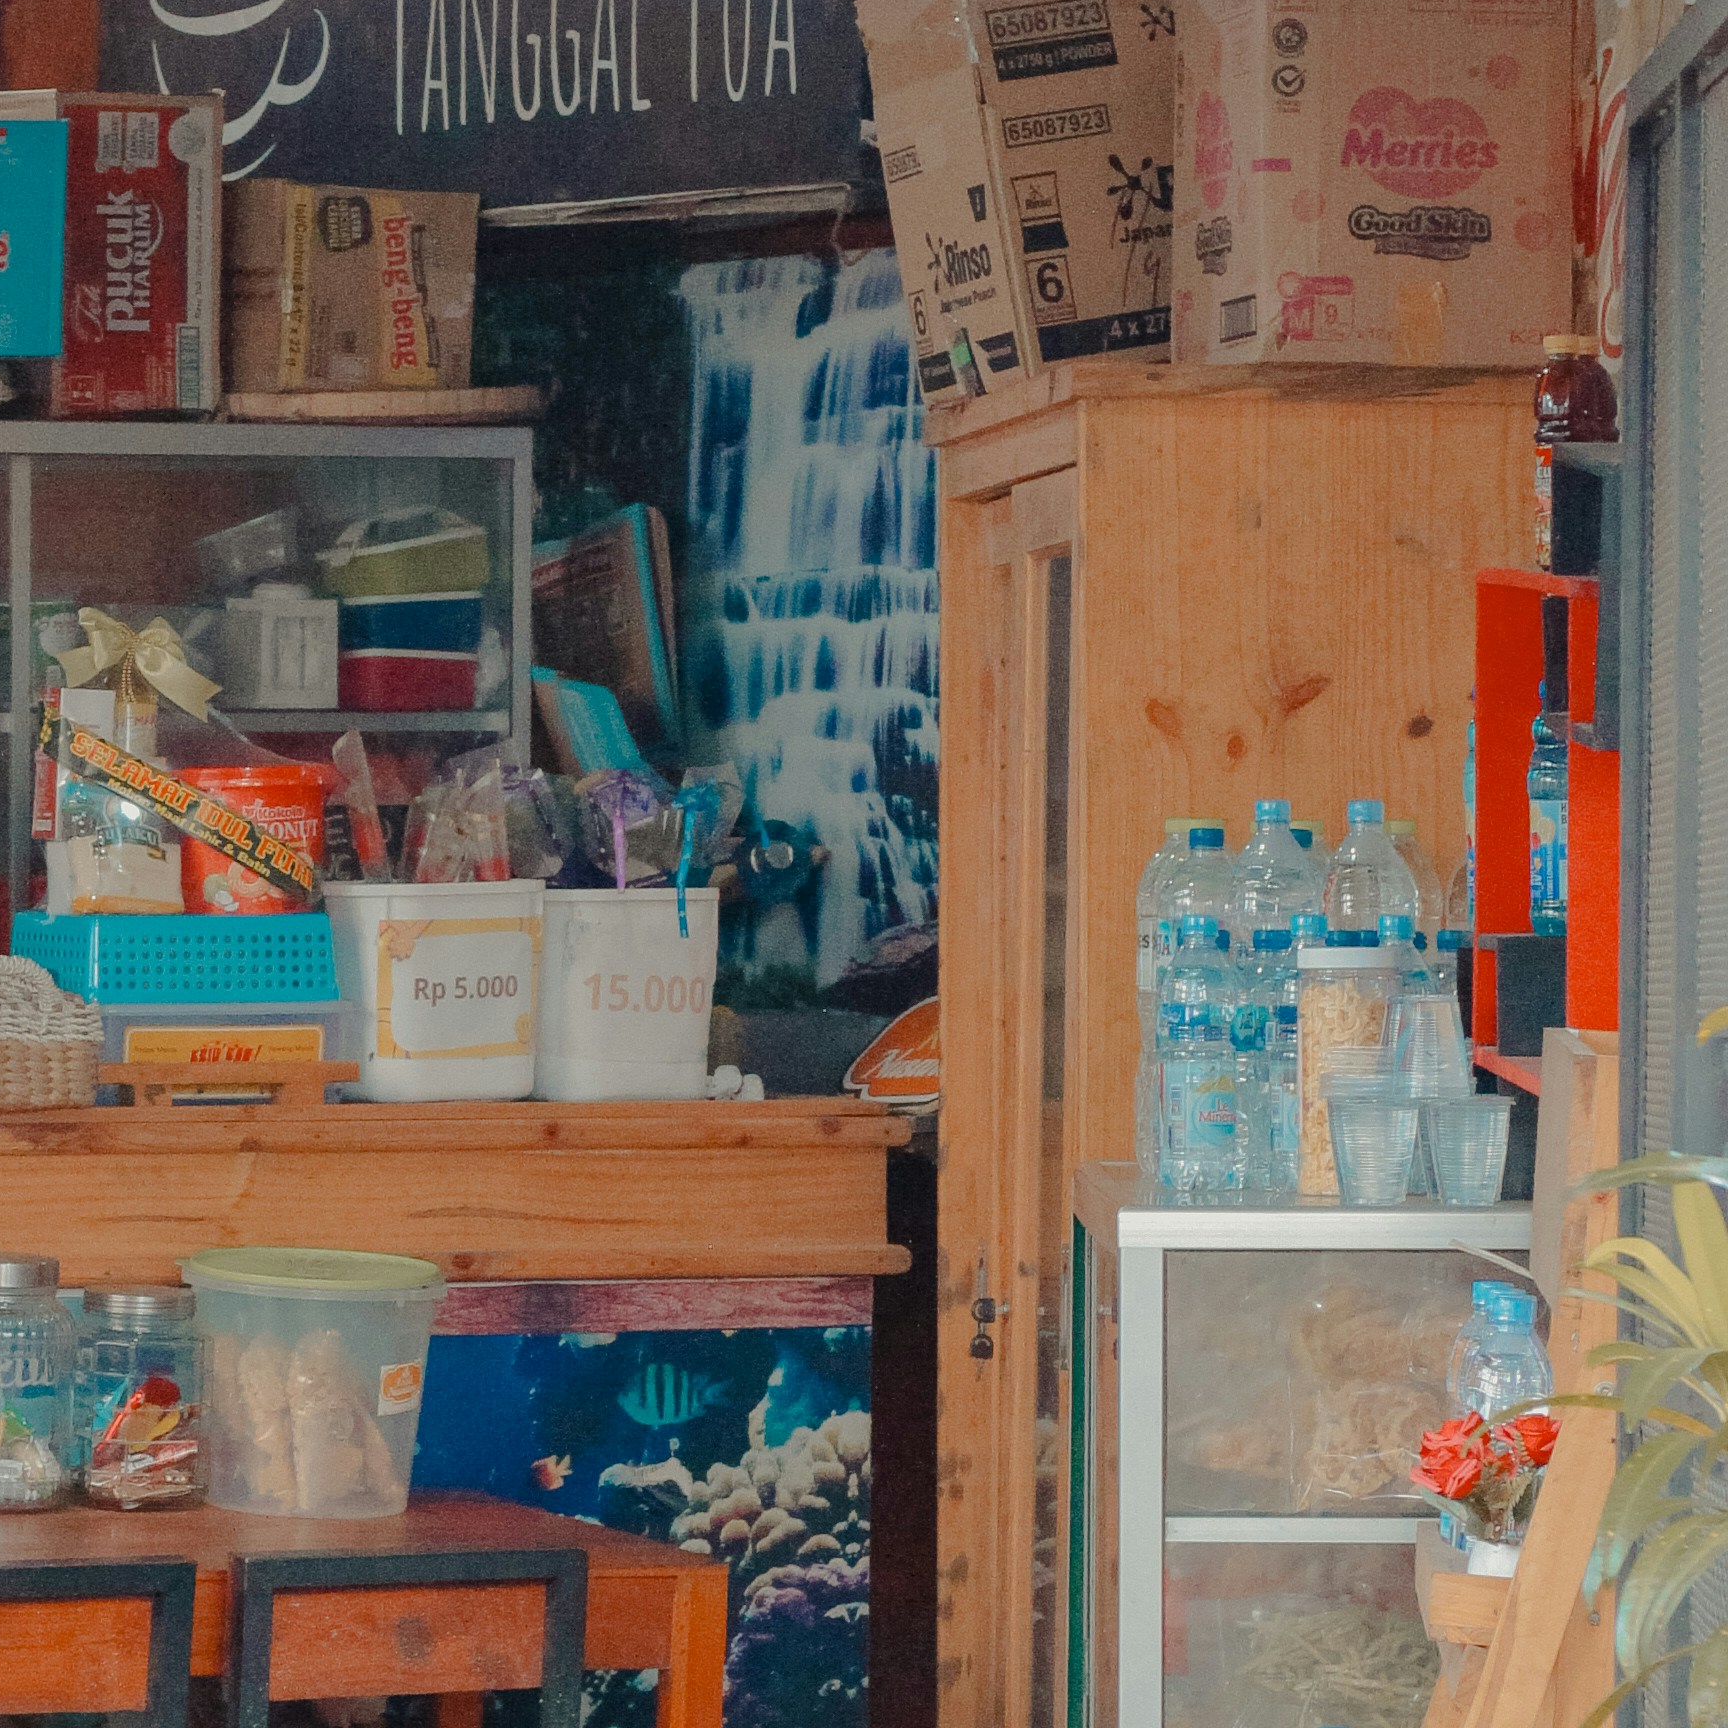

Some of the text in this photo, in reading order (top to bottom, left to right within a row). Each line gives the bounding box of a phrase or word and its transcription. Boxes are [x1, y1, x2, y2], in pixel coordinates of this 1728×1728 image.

[992, 0, 1103, 39] 65087923
[1007, 107, 1107, 142] 65087923
[1340, 128, 1501, 169] Merries
[132, 203, 153, 309] HARUM
[1036, 261, 1065, 304] 6
[70, 731, 197, 814] SELAMAT
[191, 797, 254, 852] IDUL
[413, 974, 519, 1008] Rp 5.000
[583, 973, 706, 1014] 15.000
